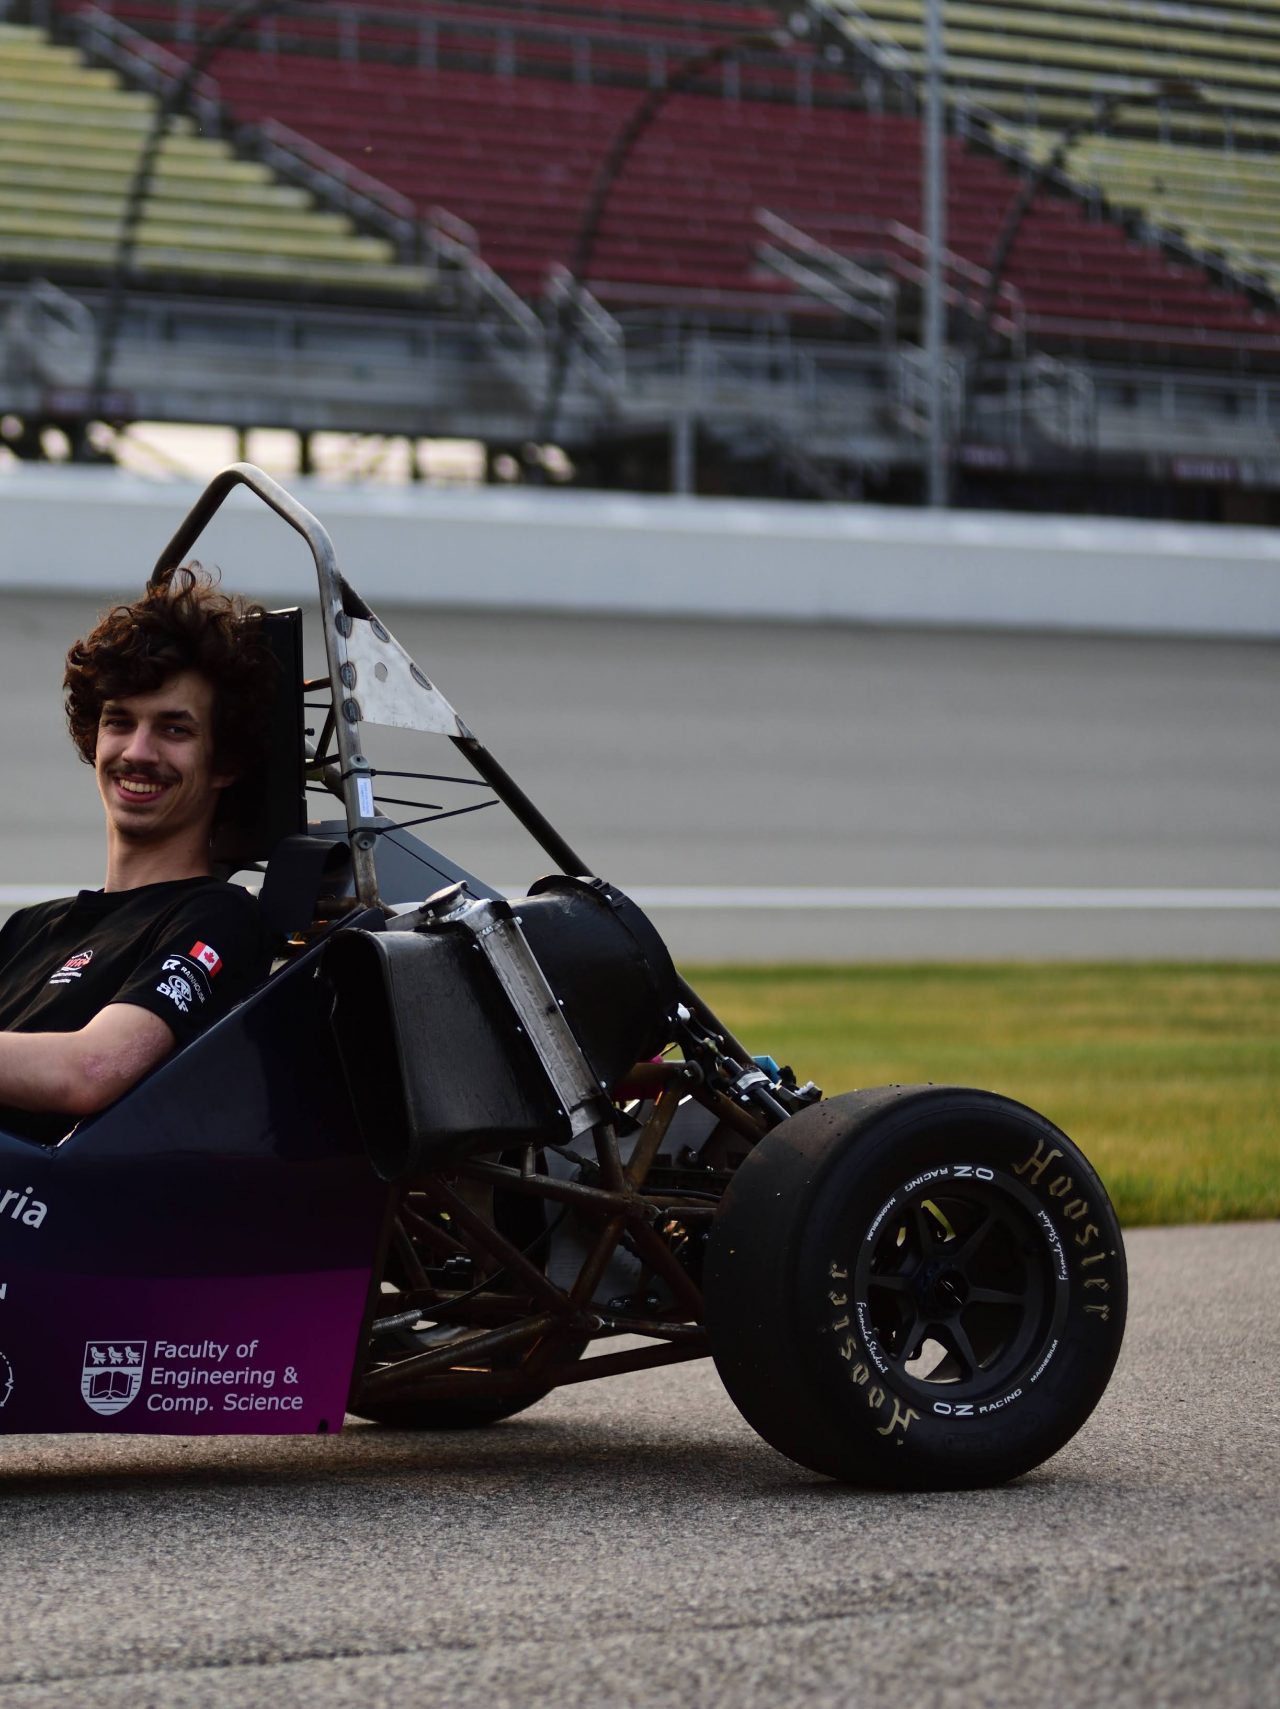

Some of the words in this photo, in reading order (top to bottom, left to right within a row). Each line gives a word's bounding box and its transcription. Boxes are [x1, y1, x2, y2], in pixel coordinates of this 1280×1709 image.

[156, 982, 189, 1012] SKF
[904, 1168, 949, 1192] RACING
[866, 1198, 897, 1241] MAGNESIUM
[1011, 1138, 1116, 1321] Hoosier
[1053, 1242, 1069, 1280] Formula
[856, 1302, 872, 1342] Formula
[153, 1340, 230, 1362] Faculty
[236, 1340, 259, 1359] of
[822, 1261, 920, 1440] Hoosier
[1030, 1339, 1059, 1383] MAGNESIUM
[150, 1367, 276, 1389] Engineering
[283, 1366, 299, 1384] &
[147, 1394, 214, 1415] Comp.
[223, 1393, 303, 1411] Science
[979, 1388, 1023, 1414] RACING
